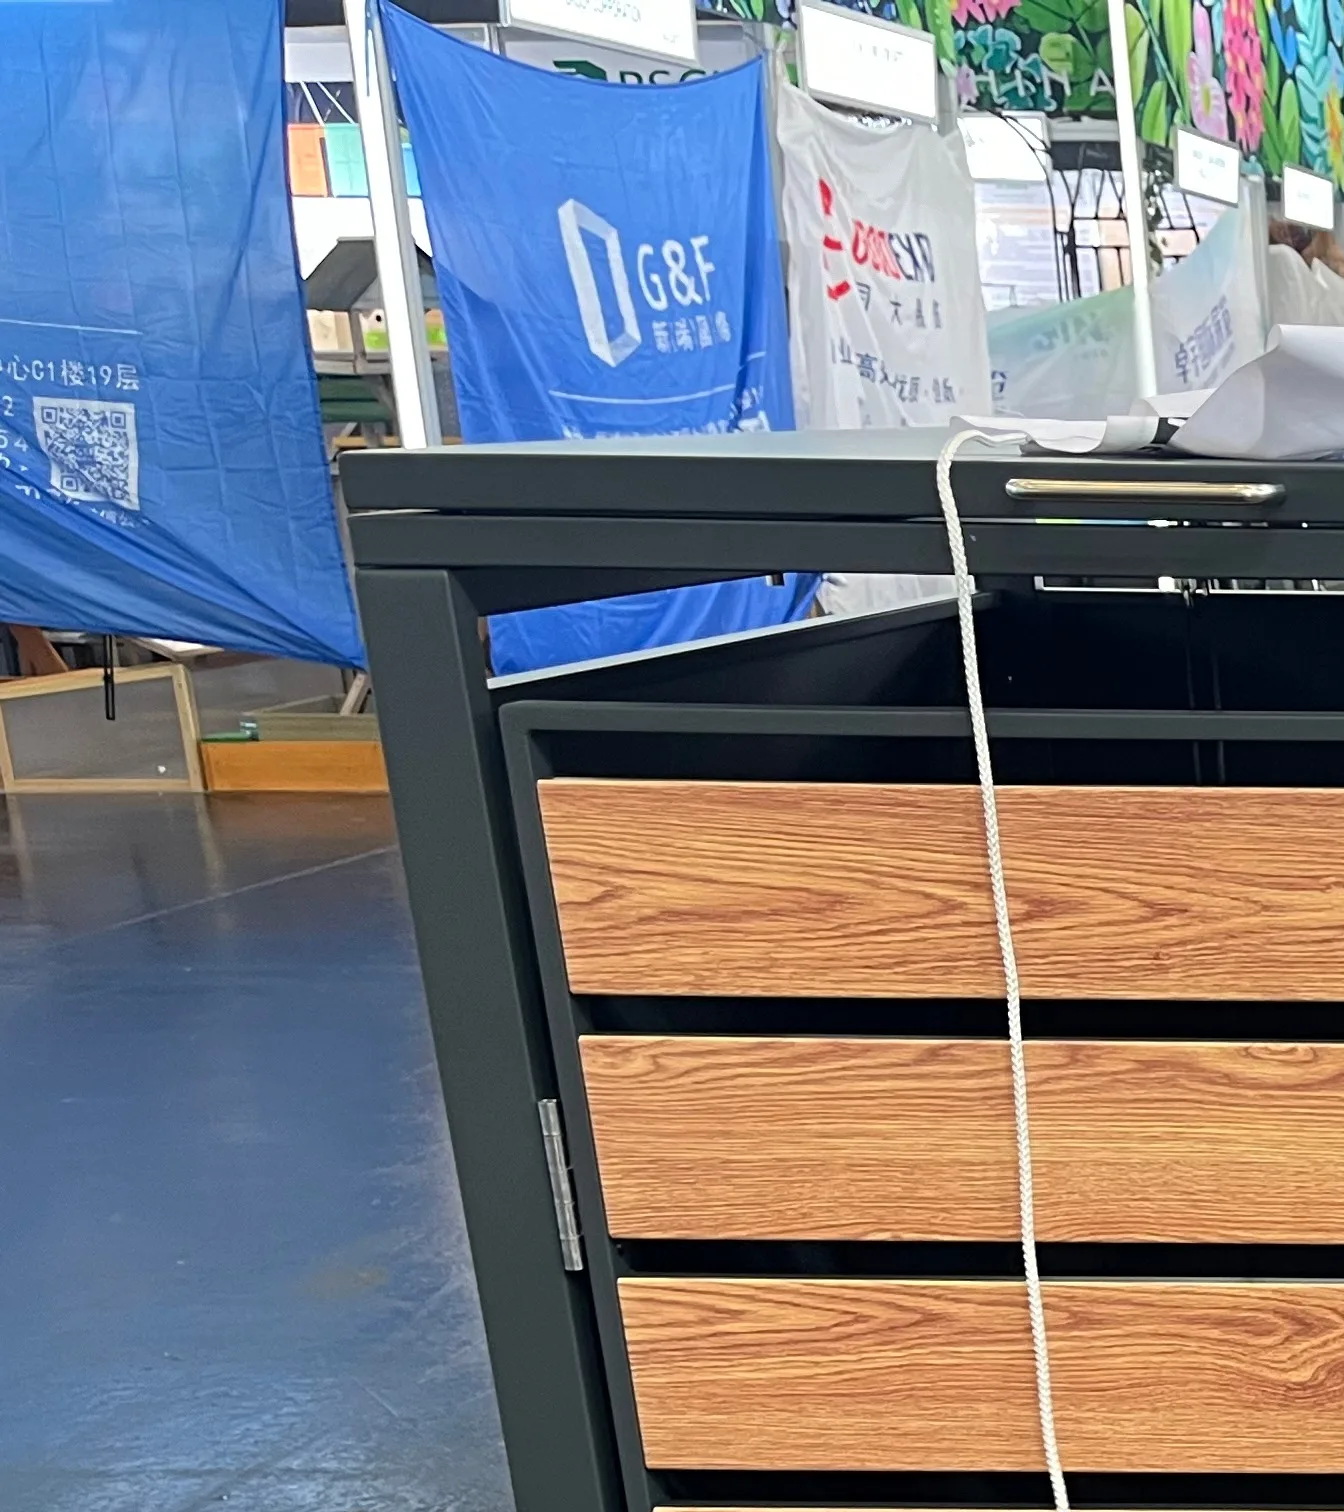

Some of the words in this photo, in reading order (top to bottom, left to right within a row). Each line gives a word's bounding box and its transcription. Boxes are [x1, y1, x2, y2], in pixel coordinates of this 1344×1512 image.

[637, 235, 716, 311] G&F
[0, 355, 140, 391] 心C1楼19层
